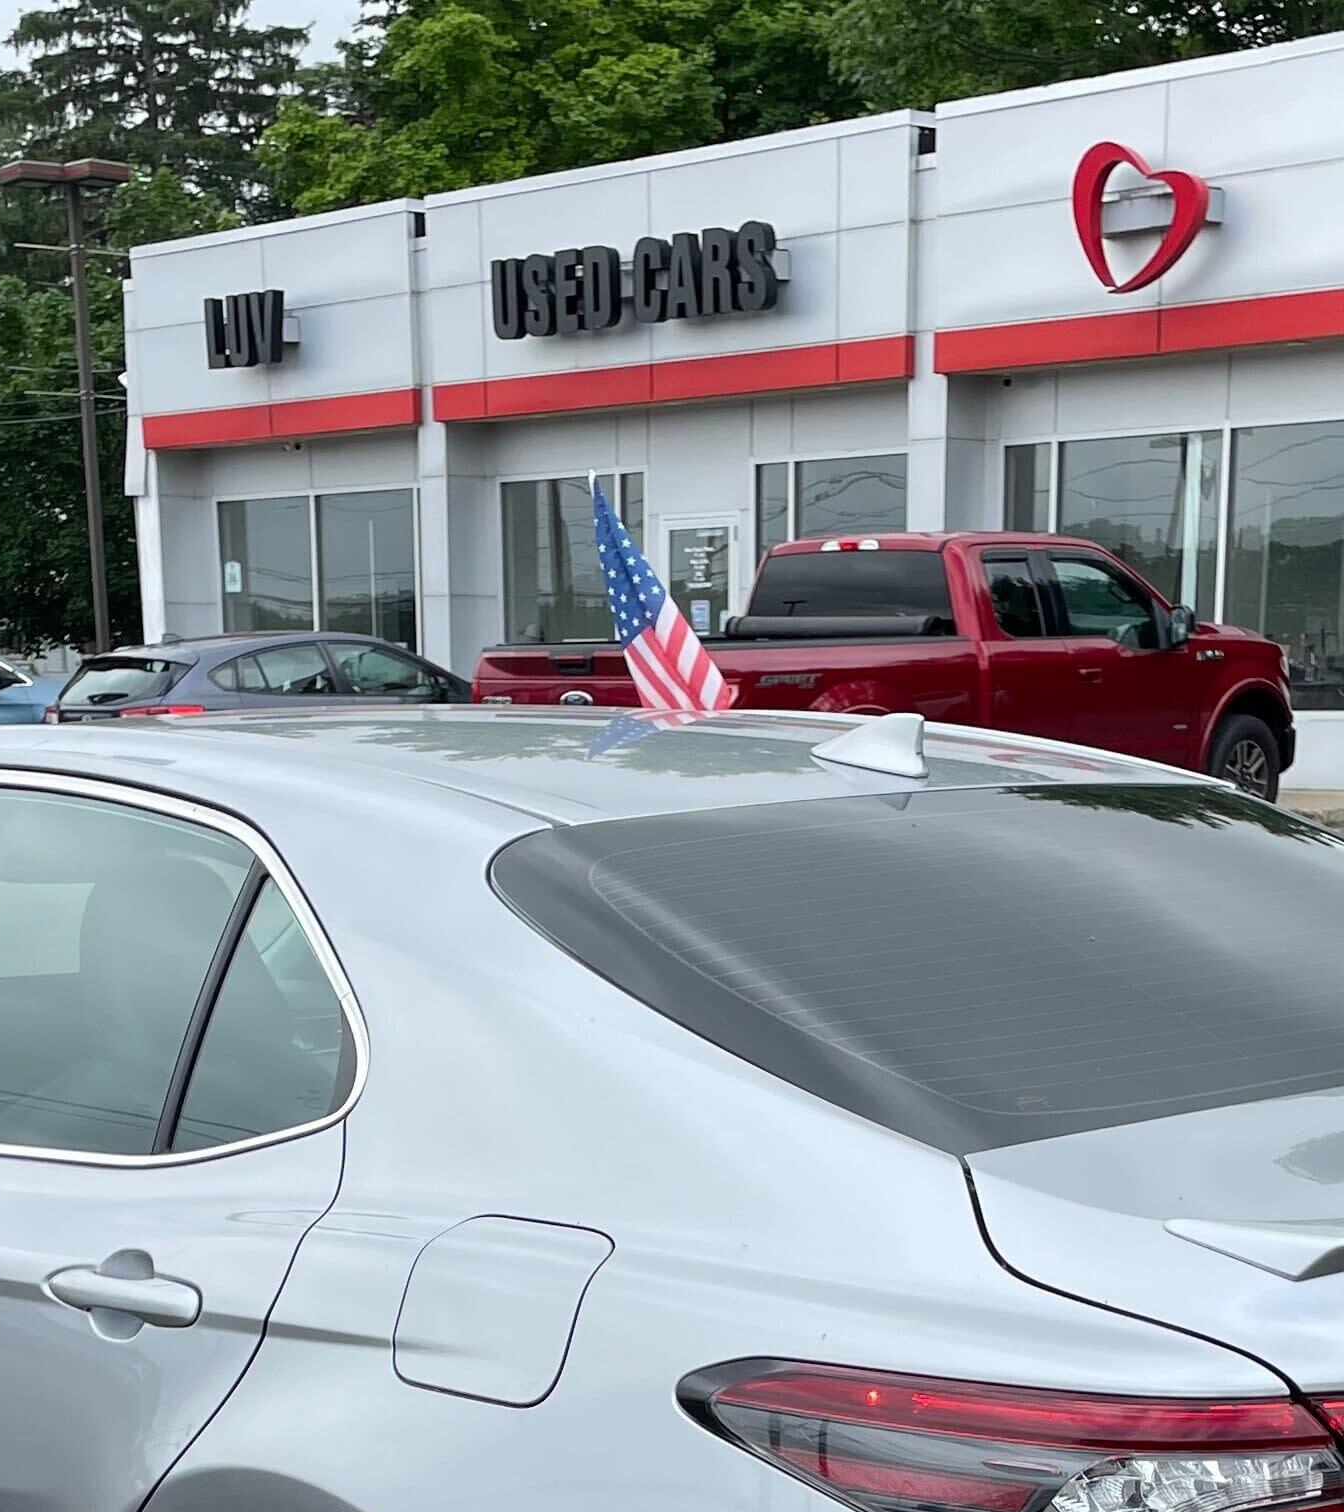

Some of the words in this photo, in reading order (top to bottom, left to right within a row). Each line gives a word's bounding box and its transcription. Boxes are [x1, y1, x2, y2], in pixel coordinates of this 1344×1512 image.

[204, 289, 285, 370] LUV
[490, 245, 621, 340] USED
[632, 221, 779, 324] CARS
